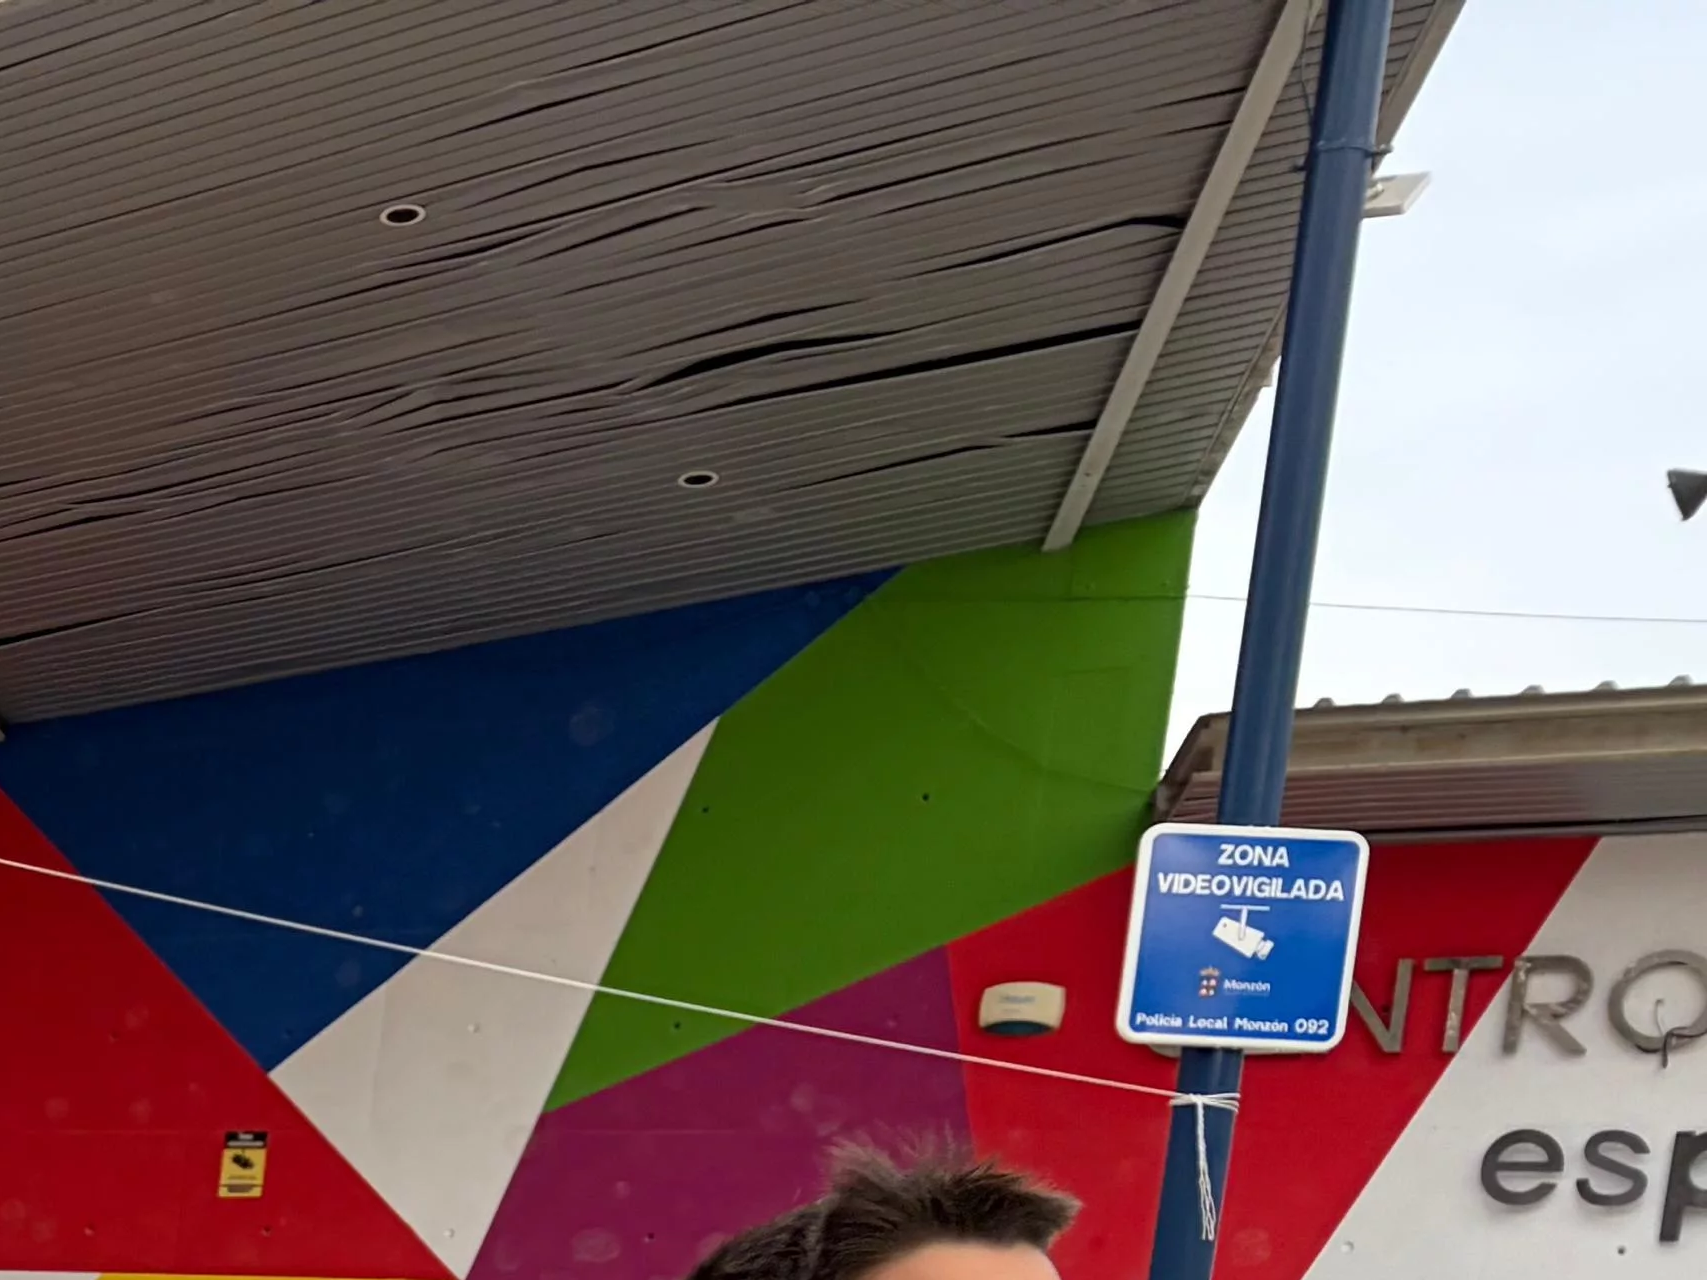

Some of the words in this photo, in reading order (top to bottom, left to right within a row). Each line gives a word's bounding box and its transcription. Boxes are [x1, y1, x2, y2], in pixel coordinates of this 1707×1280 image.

[1218, 844, 1290, 868] ZONA
[1157, 872, 1344, 901] VIDEOVIGILADA
[1349, 949, 1707, 1055] NTRO
[1189, 1014, 1227, 1030] Local
[1235, 1016, 1288, 1033] Monzón
[1294, 1018, 1329, 1035] 092
[1481, 1128, 1707, 1243] esp
